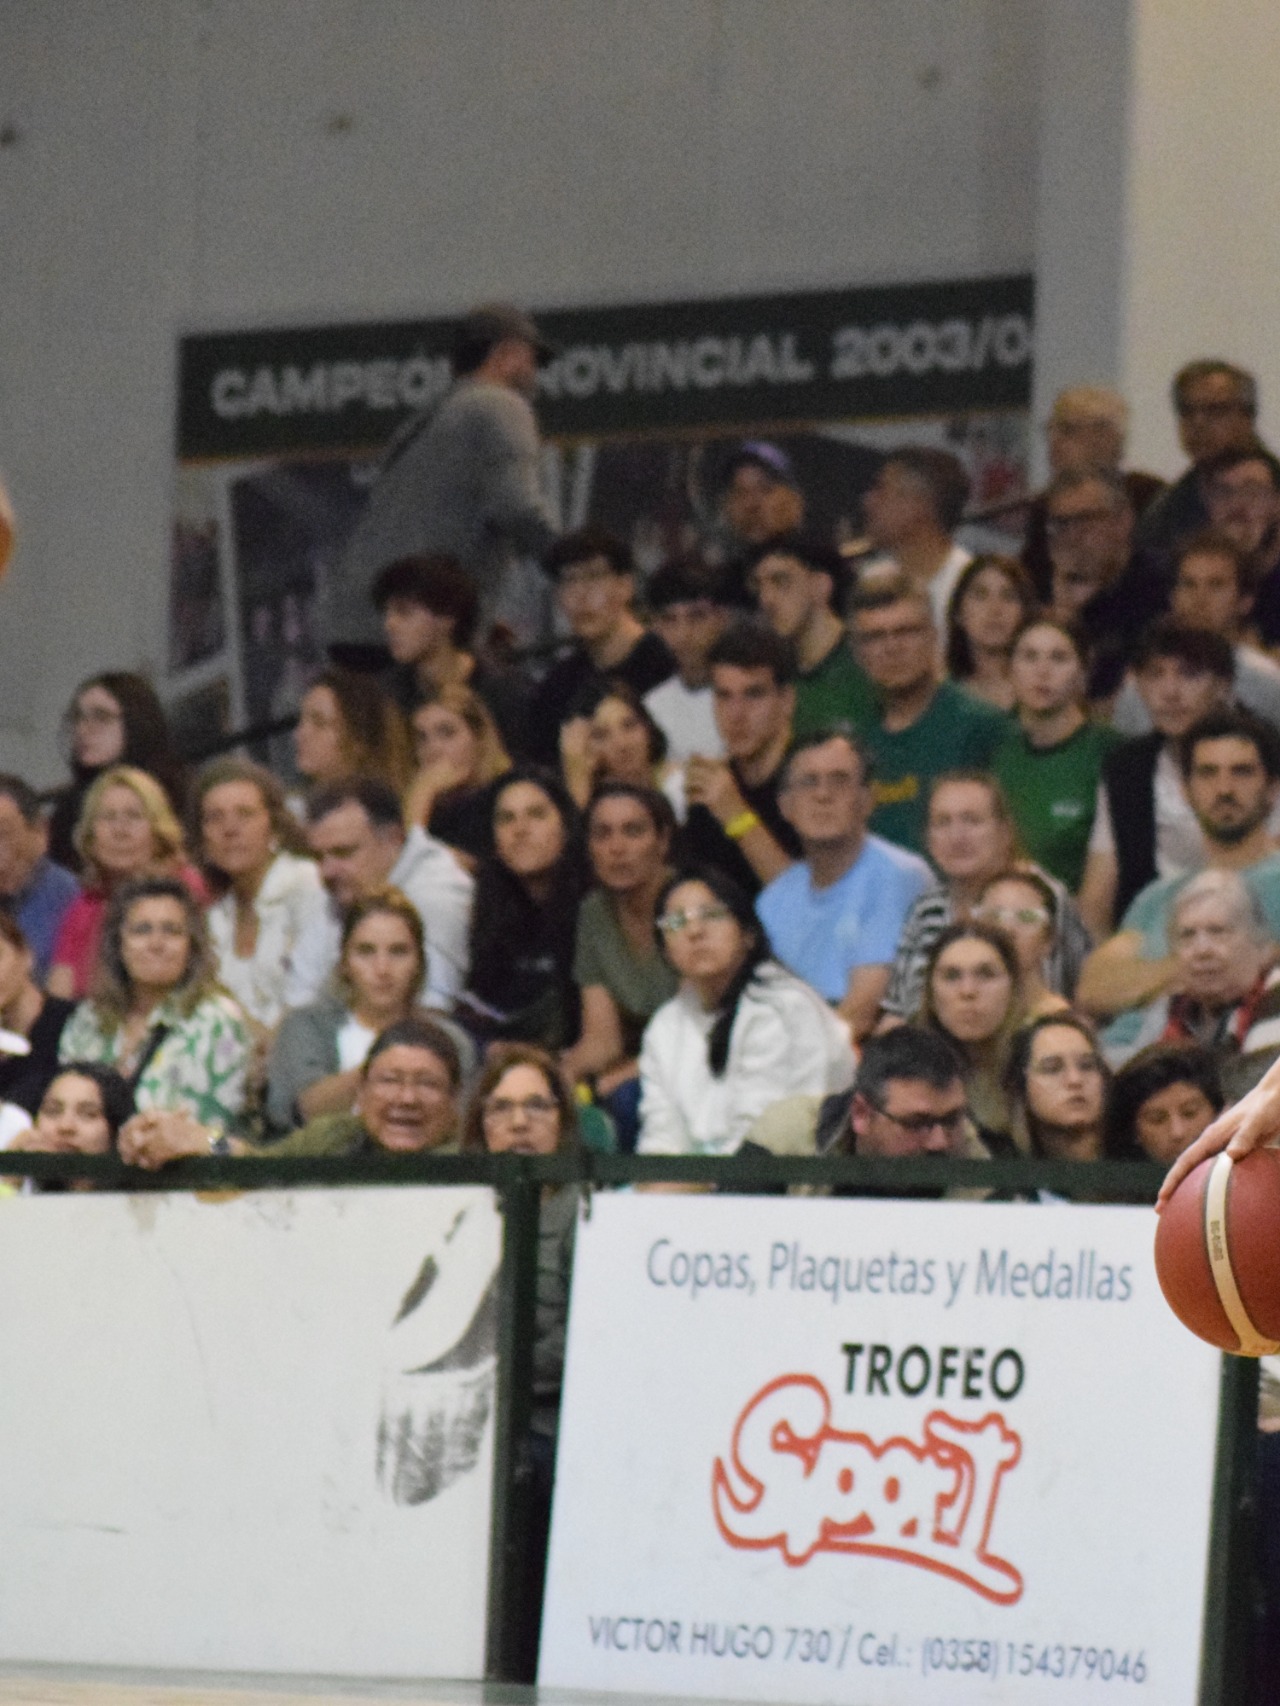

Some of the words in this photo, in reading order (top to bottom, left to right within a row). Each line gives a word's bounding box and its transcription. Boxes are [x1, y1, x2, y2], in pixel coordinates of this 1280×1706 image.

[646, 1238, 757, 1301] Copas,
[768, 1241, 937, 1304] Plaquetas
[944, 1261, 967, 1309] y
[974, 1248, 1133, 1303] Medallas
[842, 1342, 1025, 1402] TROFEO
[588, 1615, 682, 1653] VICTOR
[690, 1622, 774, 1659] HUGO
[783, 1628, 832, 1662] 730
[921, 1636, 998, 1681] (0358)
[1006, 1641, 1147, 1684] 154379046
